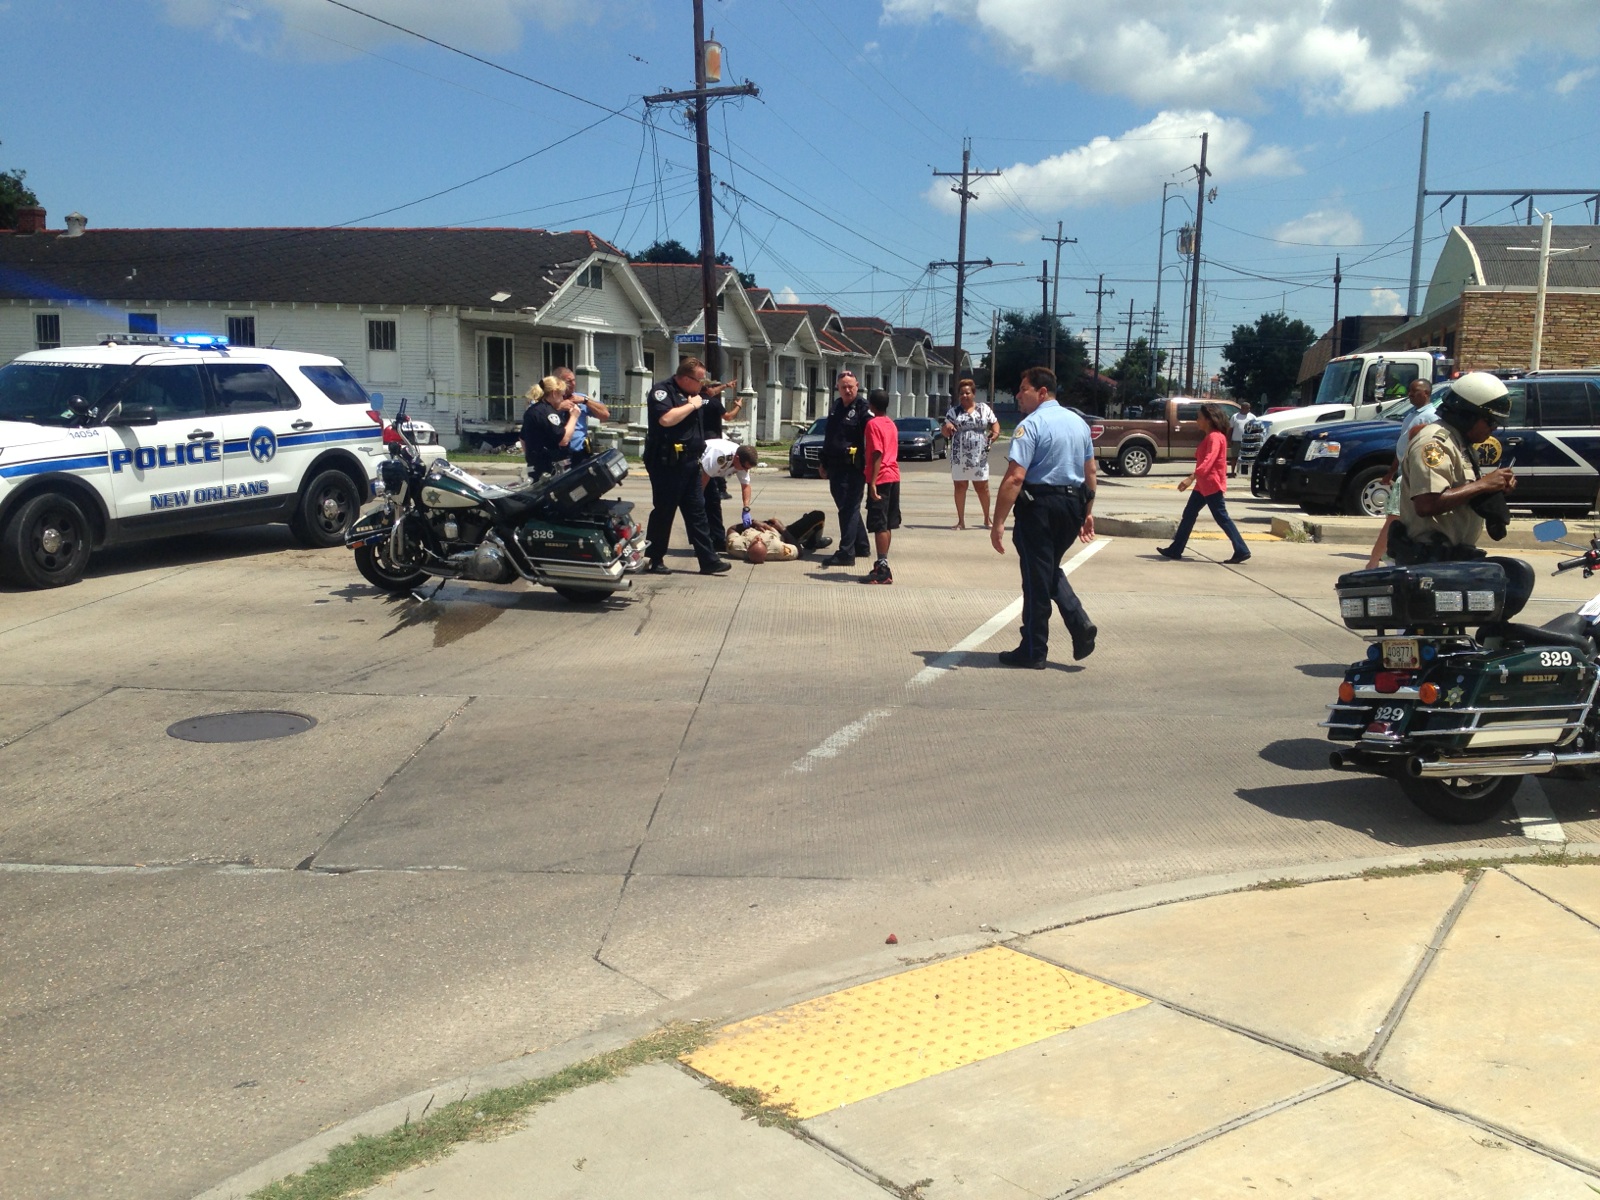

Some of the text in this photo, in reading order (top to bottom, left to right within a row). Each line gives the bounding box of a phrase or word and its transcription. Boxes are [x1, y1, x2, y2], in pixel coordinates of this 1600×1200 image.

[69, 429, 99, 439] 14054
[110, 439, 221, 474] POLICE
[151, 480, 270, 511] NEW ORLEANS
[532, 530, 554, 539] 326
[1387, 646, 1413, 658] 408771
[1540, 651, 1573, 667] 329
[1375, 706, 1404, 721] 329
